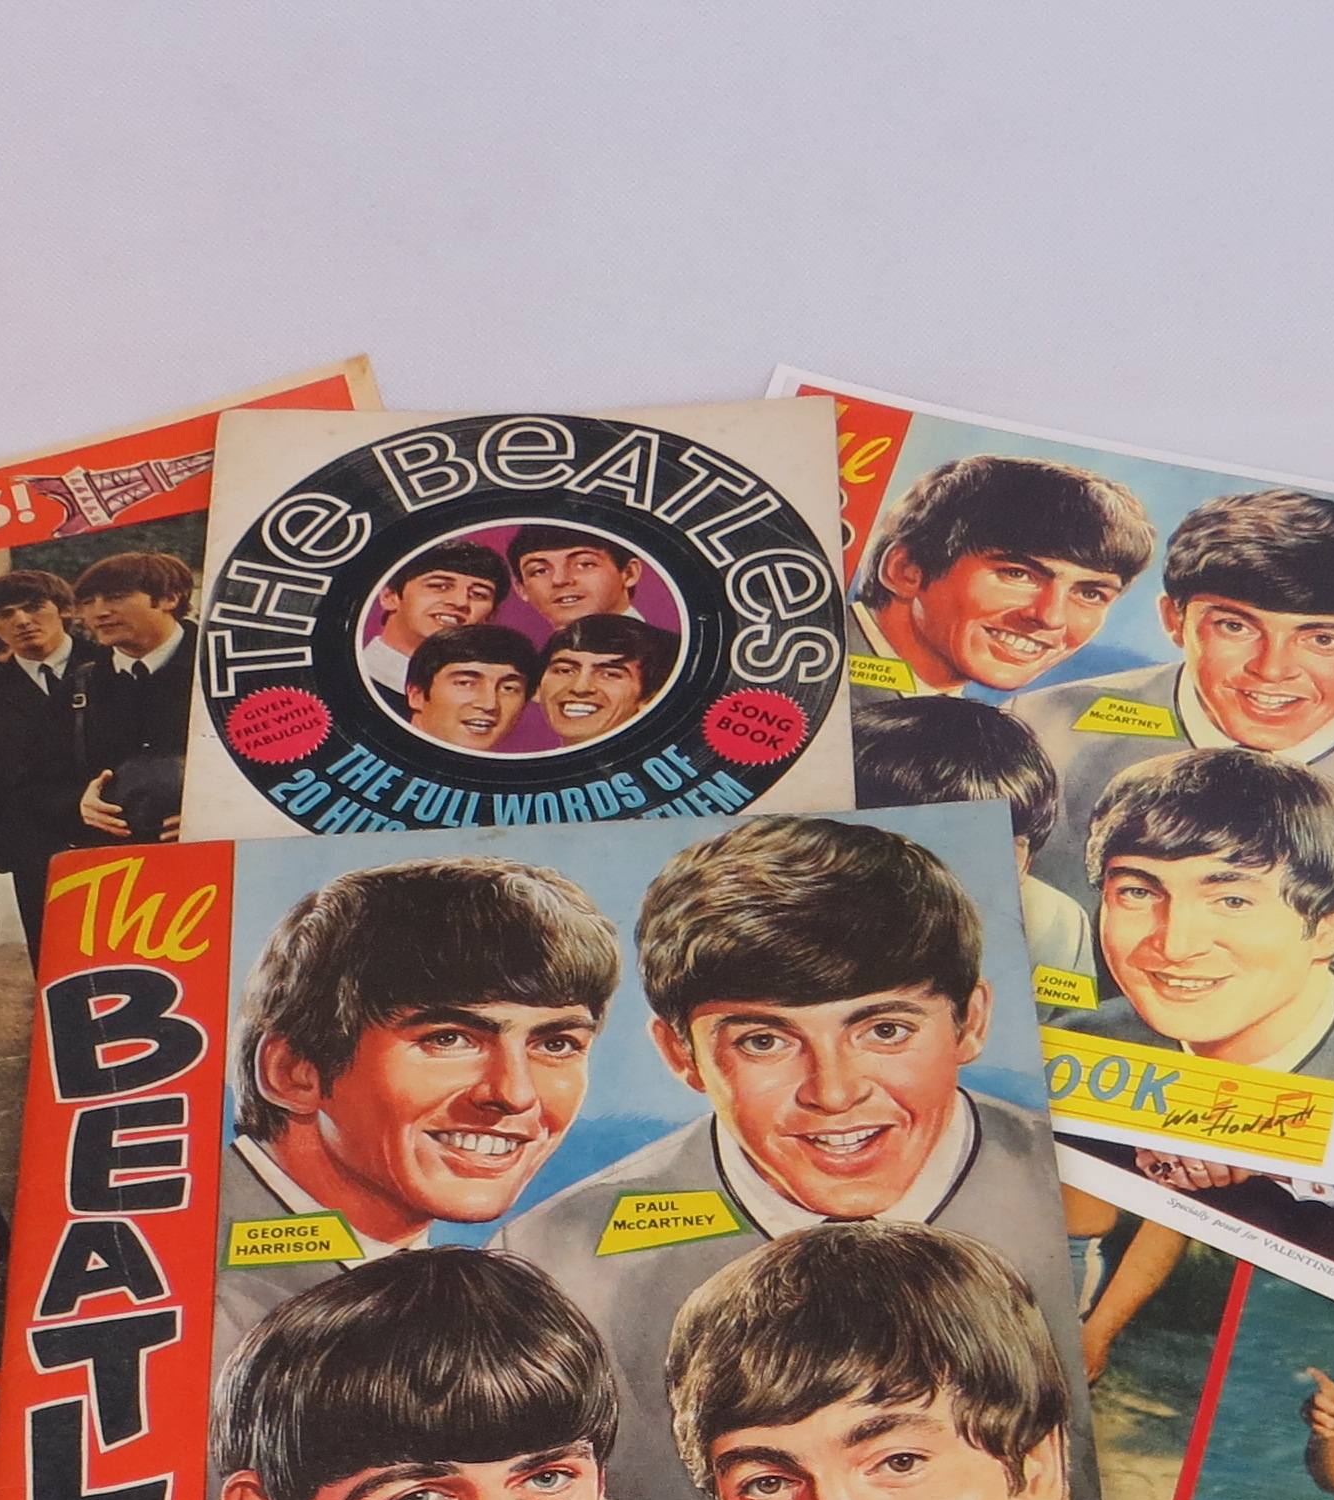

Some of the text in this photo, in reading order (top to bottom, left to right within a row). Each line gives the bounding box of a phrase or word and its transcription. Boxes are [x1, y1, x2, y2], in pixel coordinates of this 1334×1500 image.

[848, 660, 892, 674] EORGE
[848, 670, 897, 684] RRISON
[244, 698, 293, 720] GIVEN
[728, 700, 794, 732] SONG
[1108, 703, 1139, 715] PAUL
[235, 704, 315, 739] FREE WITH
[1089, 711, 1162, 729] McCARTNEY
[245, 717, 322, 751] FABULOUS
[716, 717, 785, 750] BOOK
[268, 768, 332, 816] 20
[325, 743, 700, 828] THE FULL WORDS OF
[47, 856, 218, 962] The
[1039, 975, 1078, 990] JOHN
[1033, 986, 1081, 1003] ENNON
[1044, 1053, 1181, 1115] OOK
[635, 1201, 680, 1213] PAUL
[613, 1214, 716, 1231] McCARTNEY
[1167, 1197, 1211, 1221] Specially
[1212, 1218, 1242, 1235] posed
[1241, 1230, 1260, 1242] for
[247, 1225, 320, 1240] GEORGE
[235, 1240, 331, 1256] HARRISON
